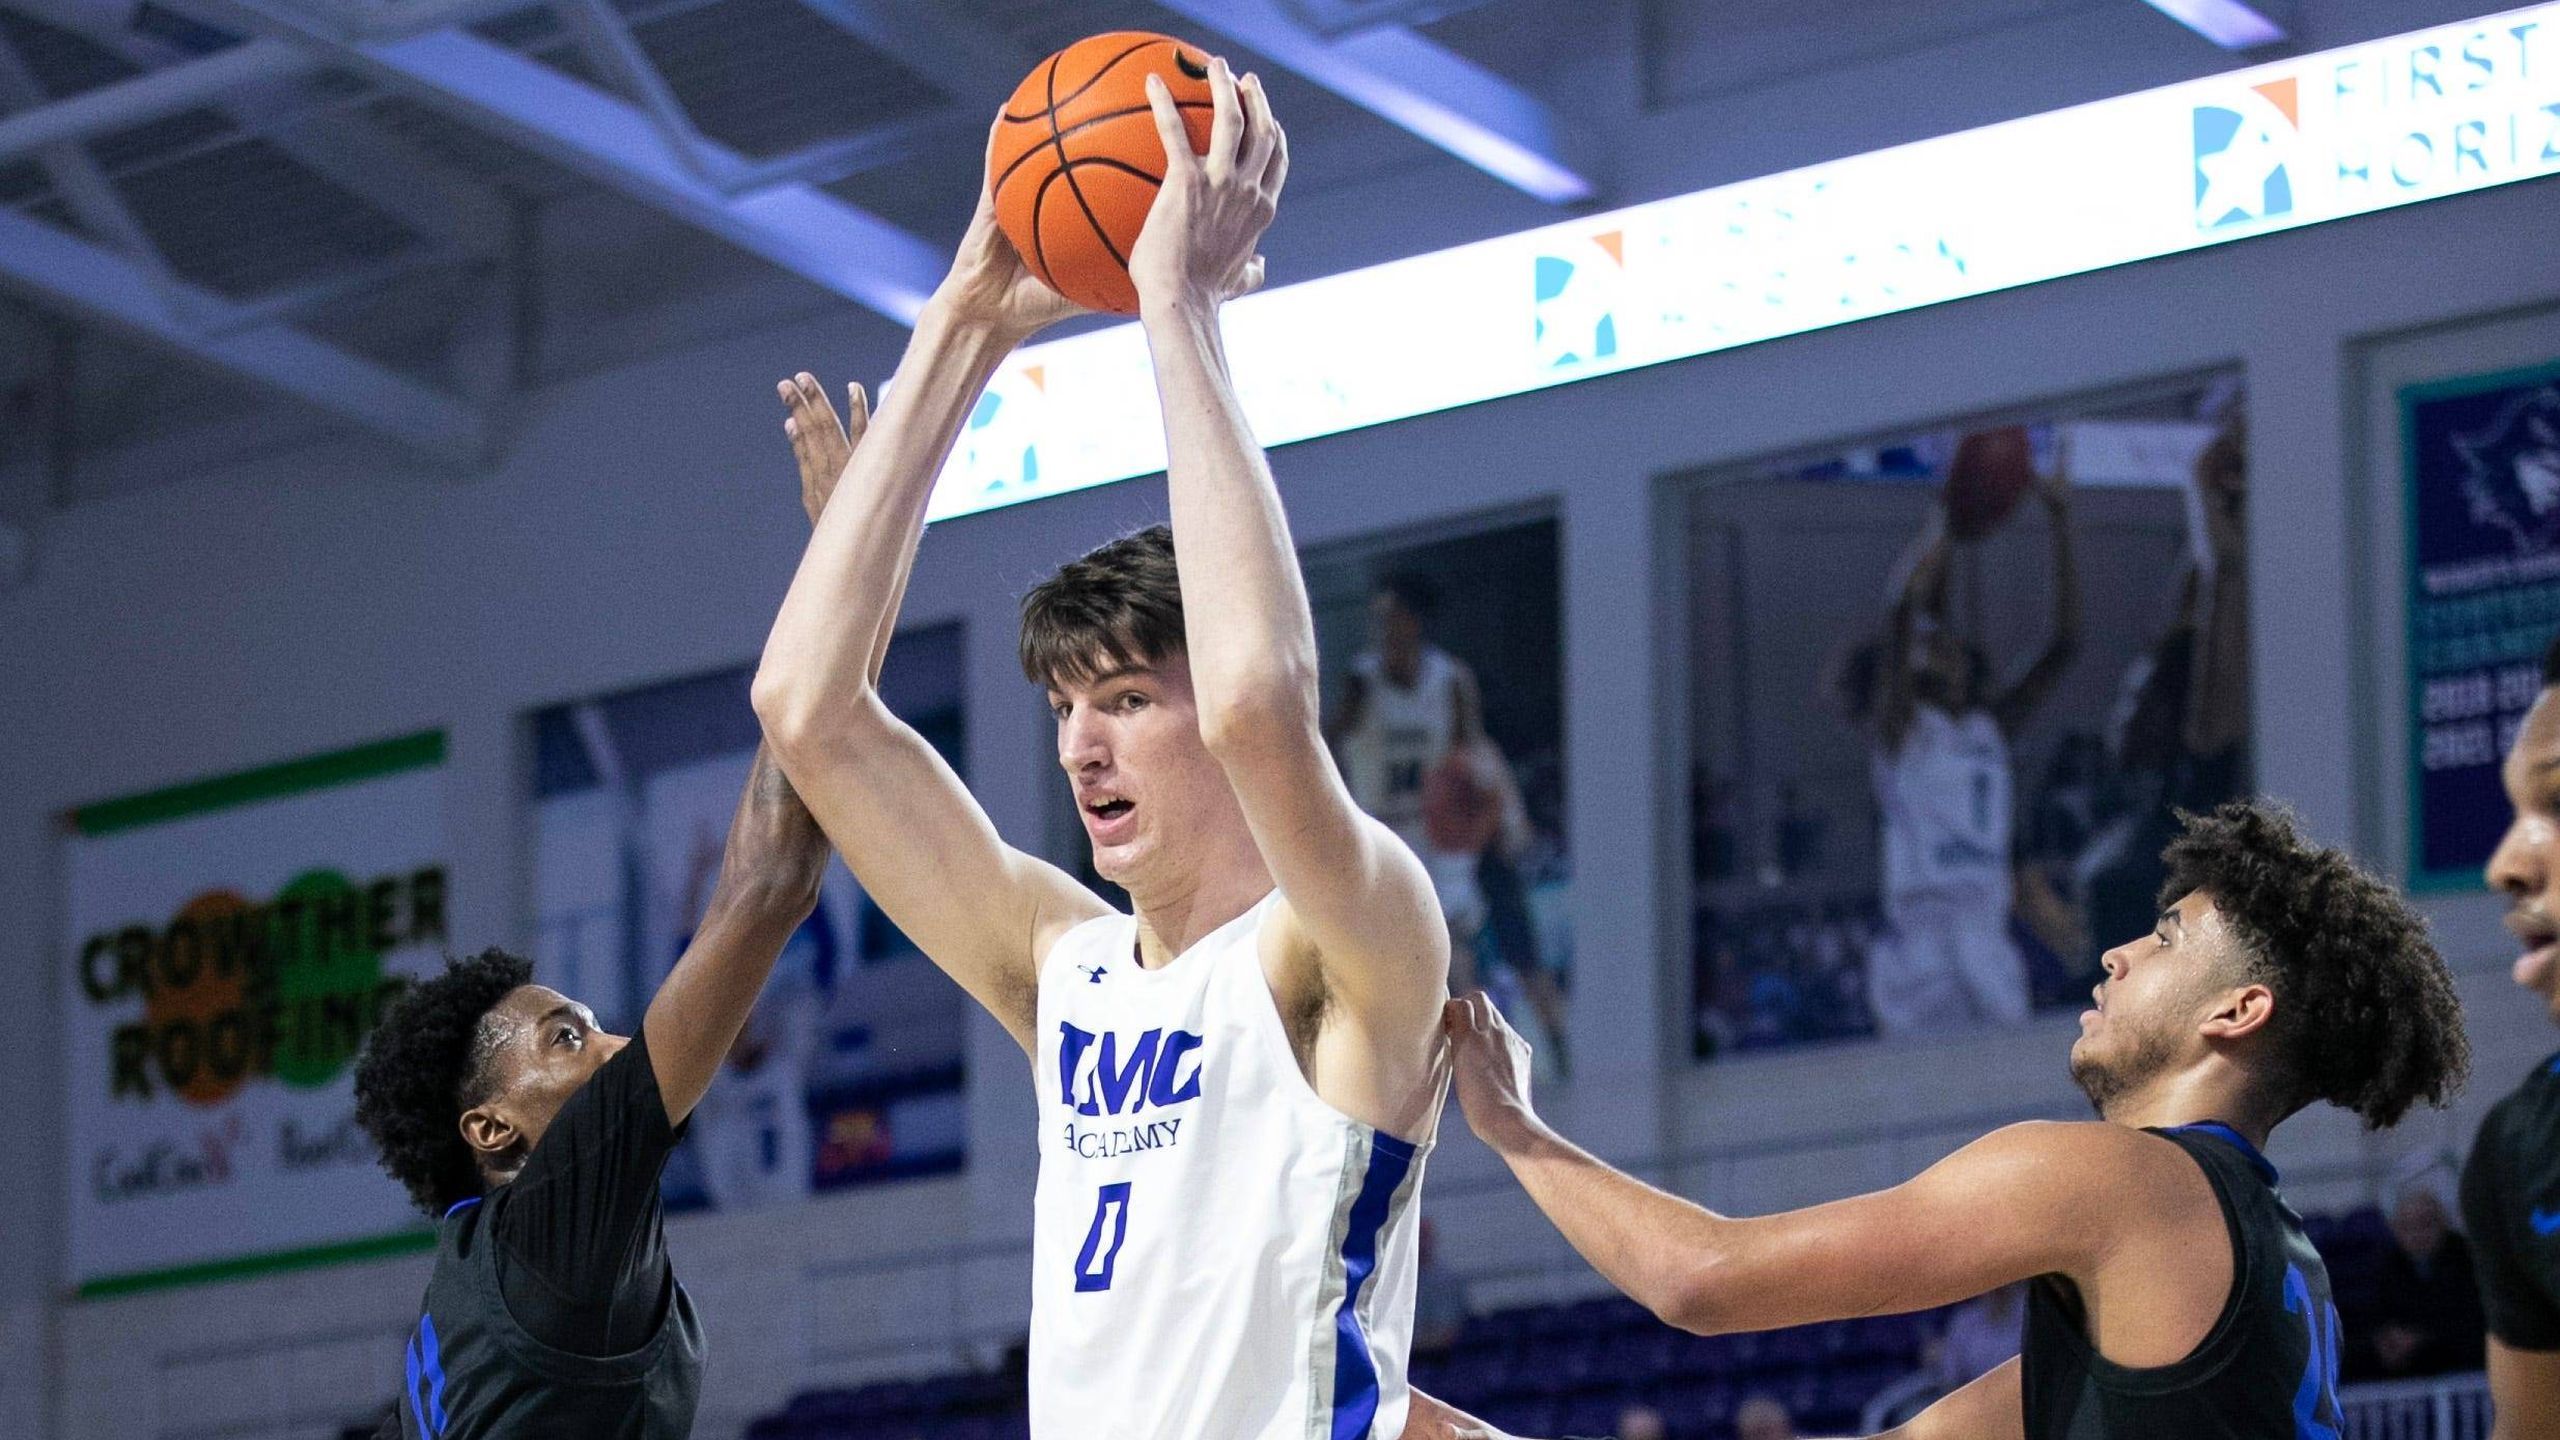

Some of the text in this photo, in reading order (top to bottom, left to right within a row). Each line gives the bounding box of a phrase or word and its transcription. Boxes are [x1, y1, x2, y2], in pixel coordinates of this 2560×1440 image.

[2334, 22, 2540, 116] FIRST
[80, 865, 447, 1004] CROWTHER
[1059, 1020, 1203, 1117] IMG
[1074, 1181, 1132, 1292] 0
